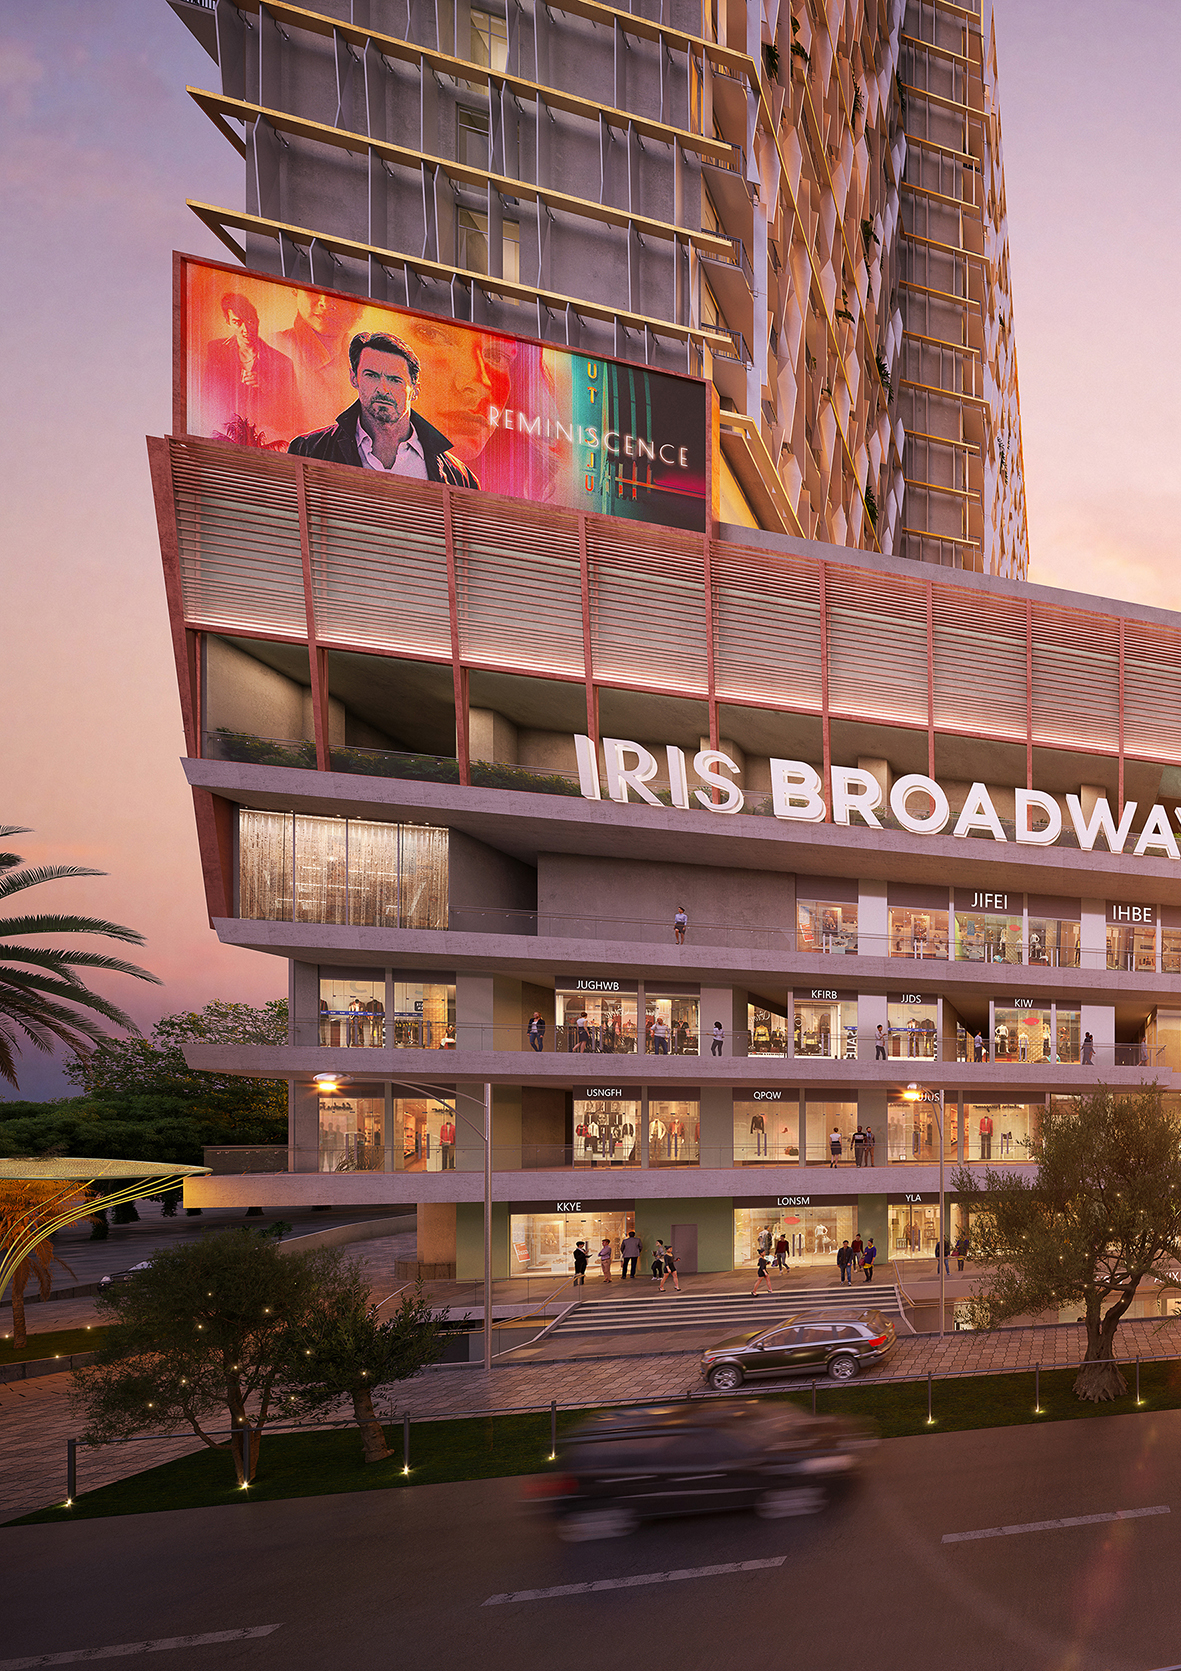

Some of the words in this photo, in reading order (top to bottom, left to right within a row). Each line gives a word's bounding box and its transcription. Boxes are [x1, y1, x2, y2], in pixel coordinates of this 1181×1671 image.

[489, 405, 689, 467] REMINISCENCE
[574, 733, 745, 815] IRIS
[971, 892, 1008, 910] JIFEI
[1112, 905, 1152, 923] IHBE
[576, 980, 620, 991] JUGHWB
[811, 989, 838, 999] KFIRB
[900, 994, 922, 1004] JJDS
[1014, 998, 1033, 1008] KIW
[586, 1088, 622, 1097] USNGFH
[753, 1091, 782, 1100] QPQW
[777, 1196, 810, 1206] LONSM
[905, 1194, 922, 1202] YLA
[556, 1202, 582, 1212] KKYE
